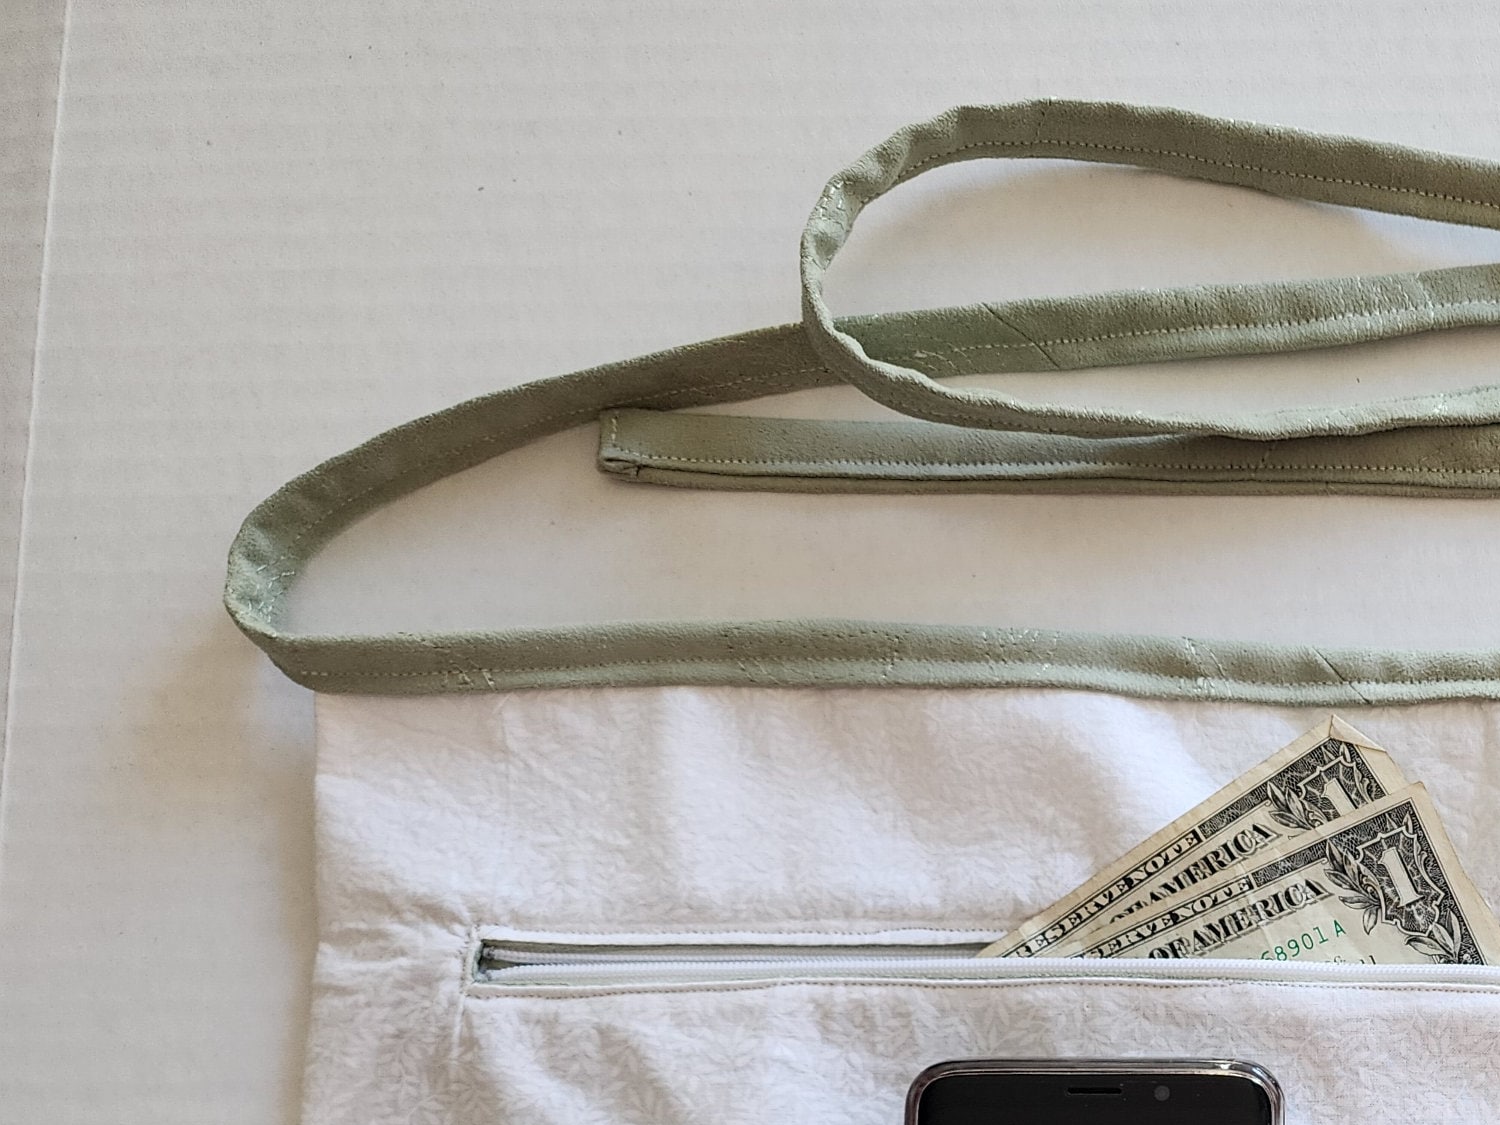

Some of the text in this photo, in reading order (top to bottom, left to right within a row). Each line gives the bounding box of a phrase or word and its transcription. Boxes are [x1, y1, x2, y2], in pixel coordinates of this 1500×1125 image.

[1129, 833, 1199, 885] NOTE
[1150, 822, 1283, 902] AMERICA
[1073, 914, 1174, 958] SERVE
[1176, 876, 1250, 920] NOTE
[1192, 878, 1334, 955] AMERICA
[1334, 920, 1346, 937] A
